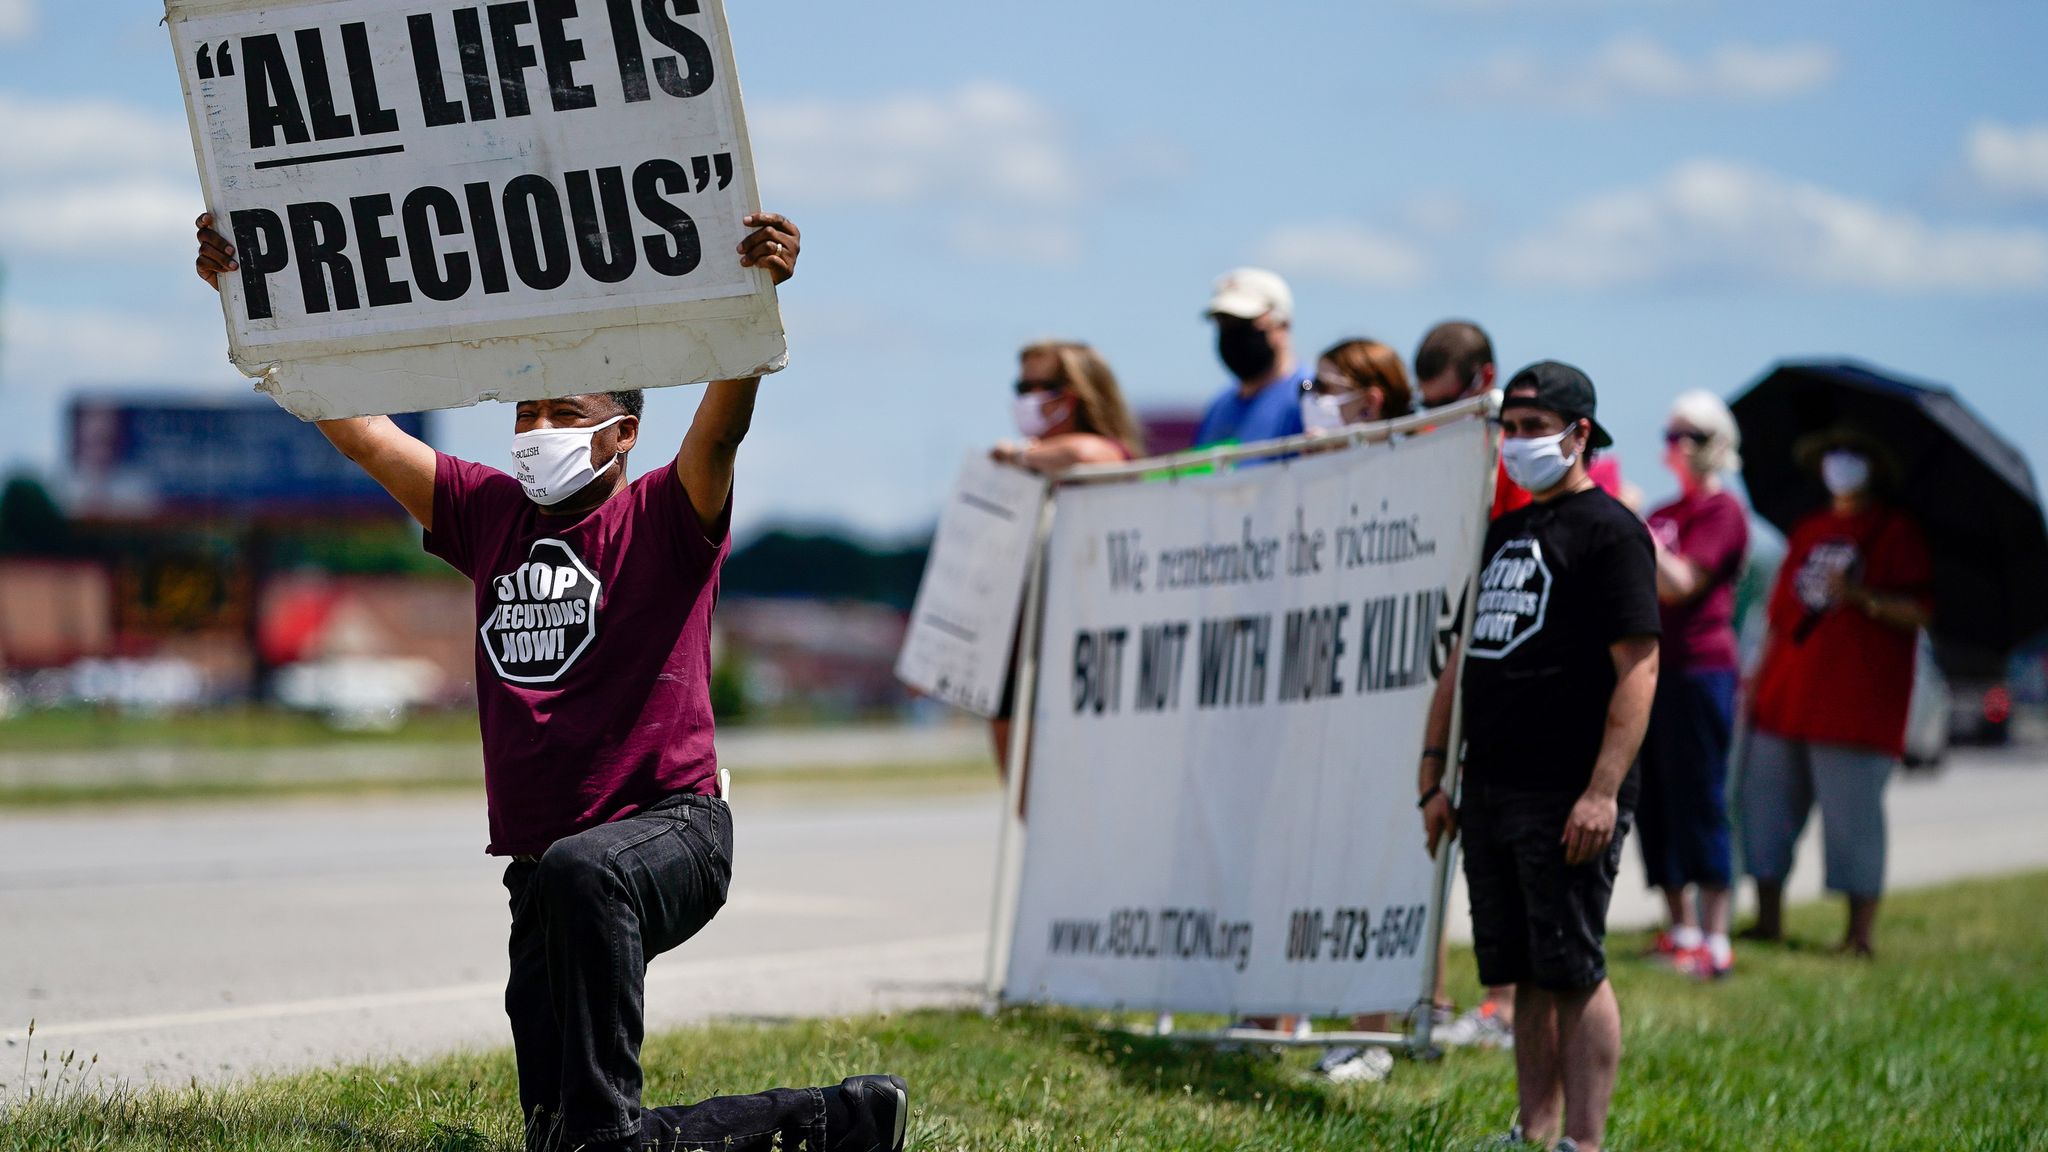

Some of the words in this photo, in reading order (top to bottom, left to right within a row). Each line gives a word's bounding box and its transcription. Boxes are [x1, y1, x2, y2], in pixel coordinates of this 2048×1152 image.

[406, 0, 597, 127] LIFE
[609, 0, 714, 103] IS
[516, 471, 536, 484] DEATH
[523, 485, 549, 498] ALTY
[1106, 527, 1149, 592] We
[1155, 515, 1280, 591] remember
[1286, 506, 1326, 576] the
[498, 562, 579, 601] STOP
[494, 599, 586, 630] ECUTIONS
[1473, 612, 1517, 641] OW!
[501, 628, 565, 663] NOW!
[1072, 623, 1129, 716] BUT
[1134, 620, 1190, 713] NOT
[1197, 612, 1273, 709] WITH
[1279, 602, 1350, 703] MORE
